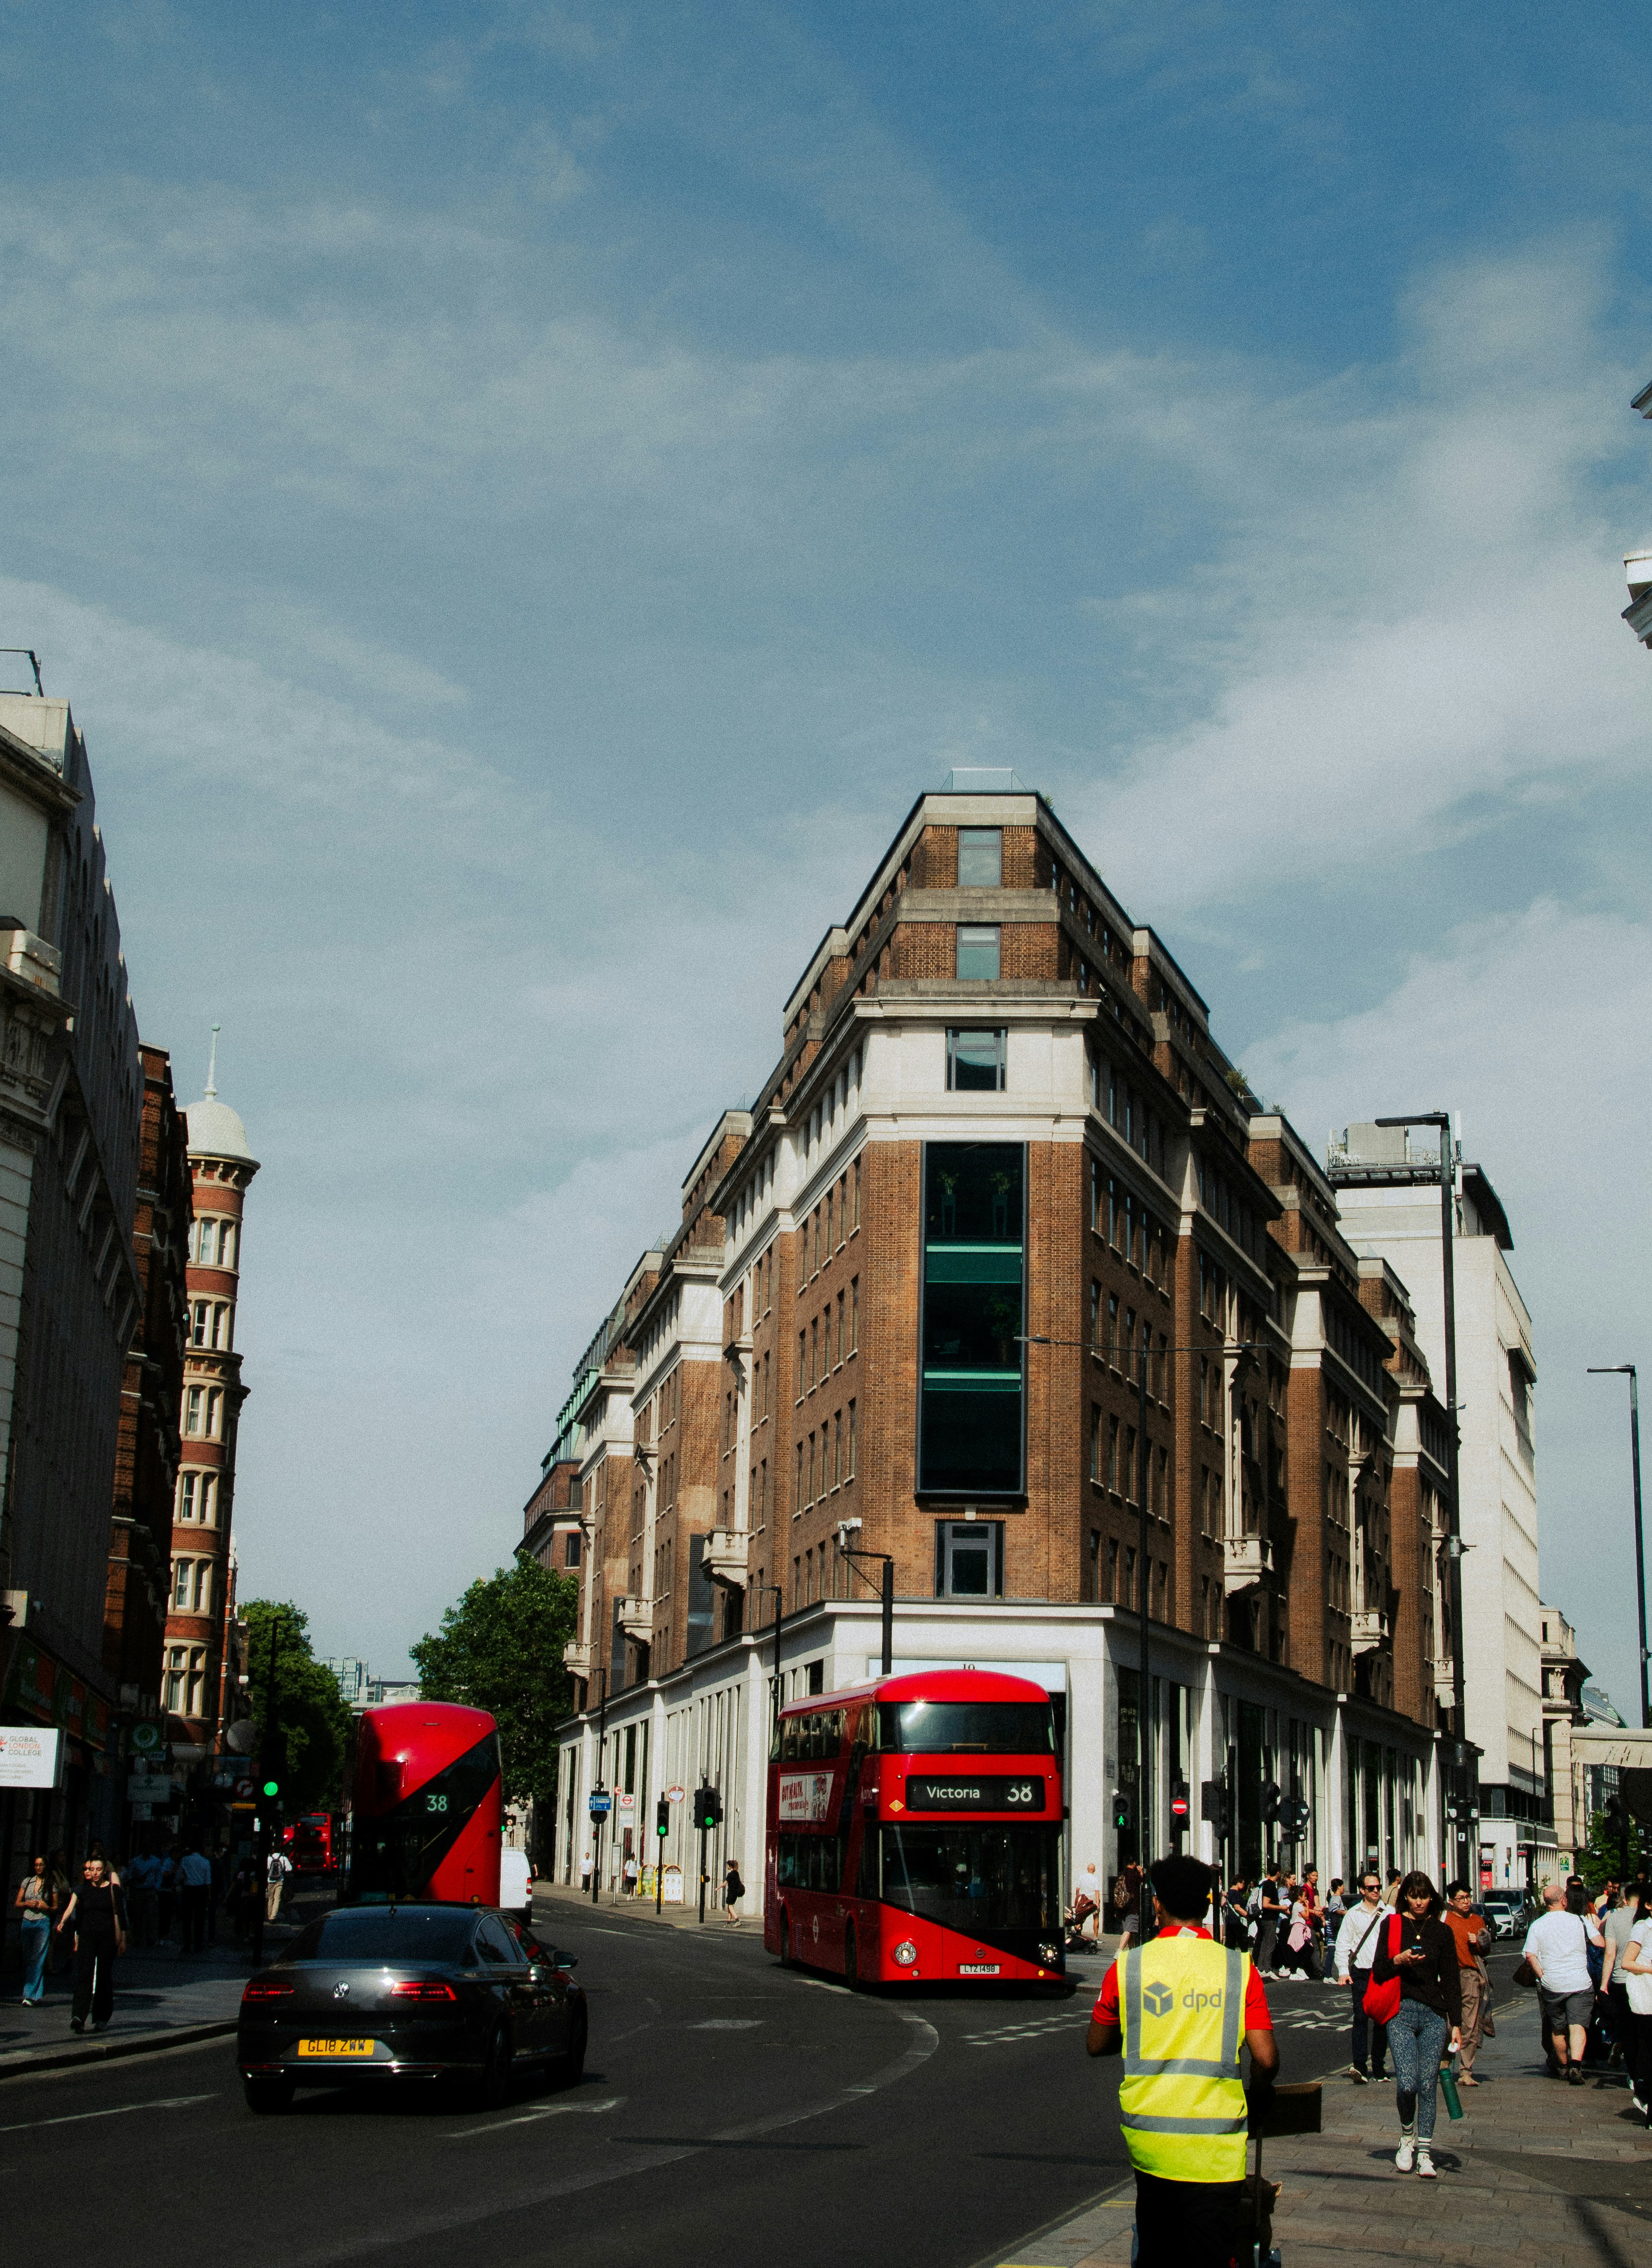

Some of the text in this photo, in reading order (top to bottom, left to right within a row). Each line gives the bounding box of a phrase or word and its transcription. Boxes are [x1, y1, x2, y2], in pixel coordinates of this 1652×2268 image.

[926, 1782, 1033, 1802] Victoria 38
[427, 1795, 448, 1812] 38
[1182, 1987, 1222, 2013] dpd
[308, 2040, 337, 2052] GL18
